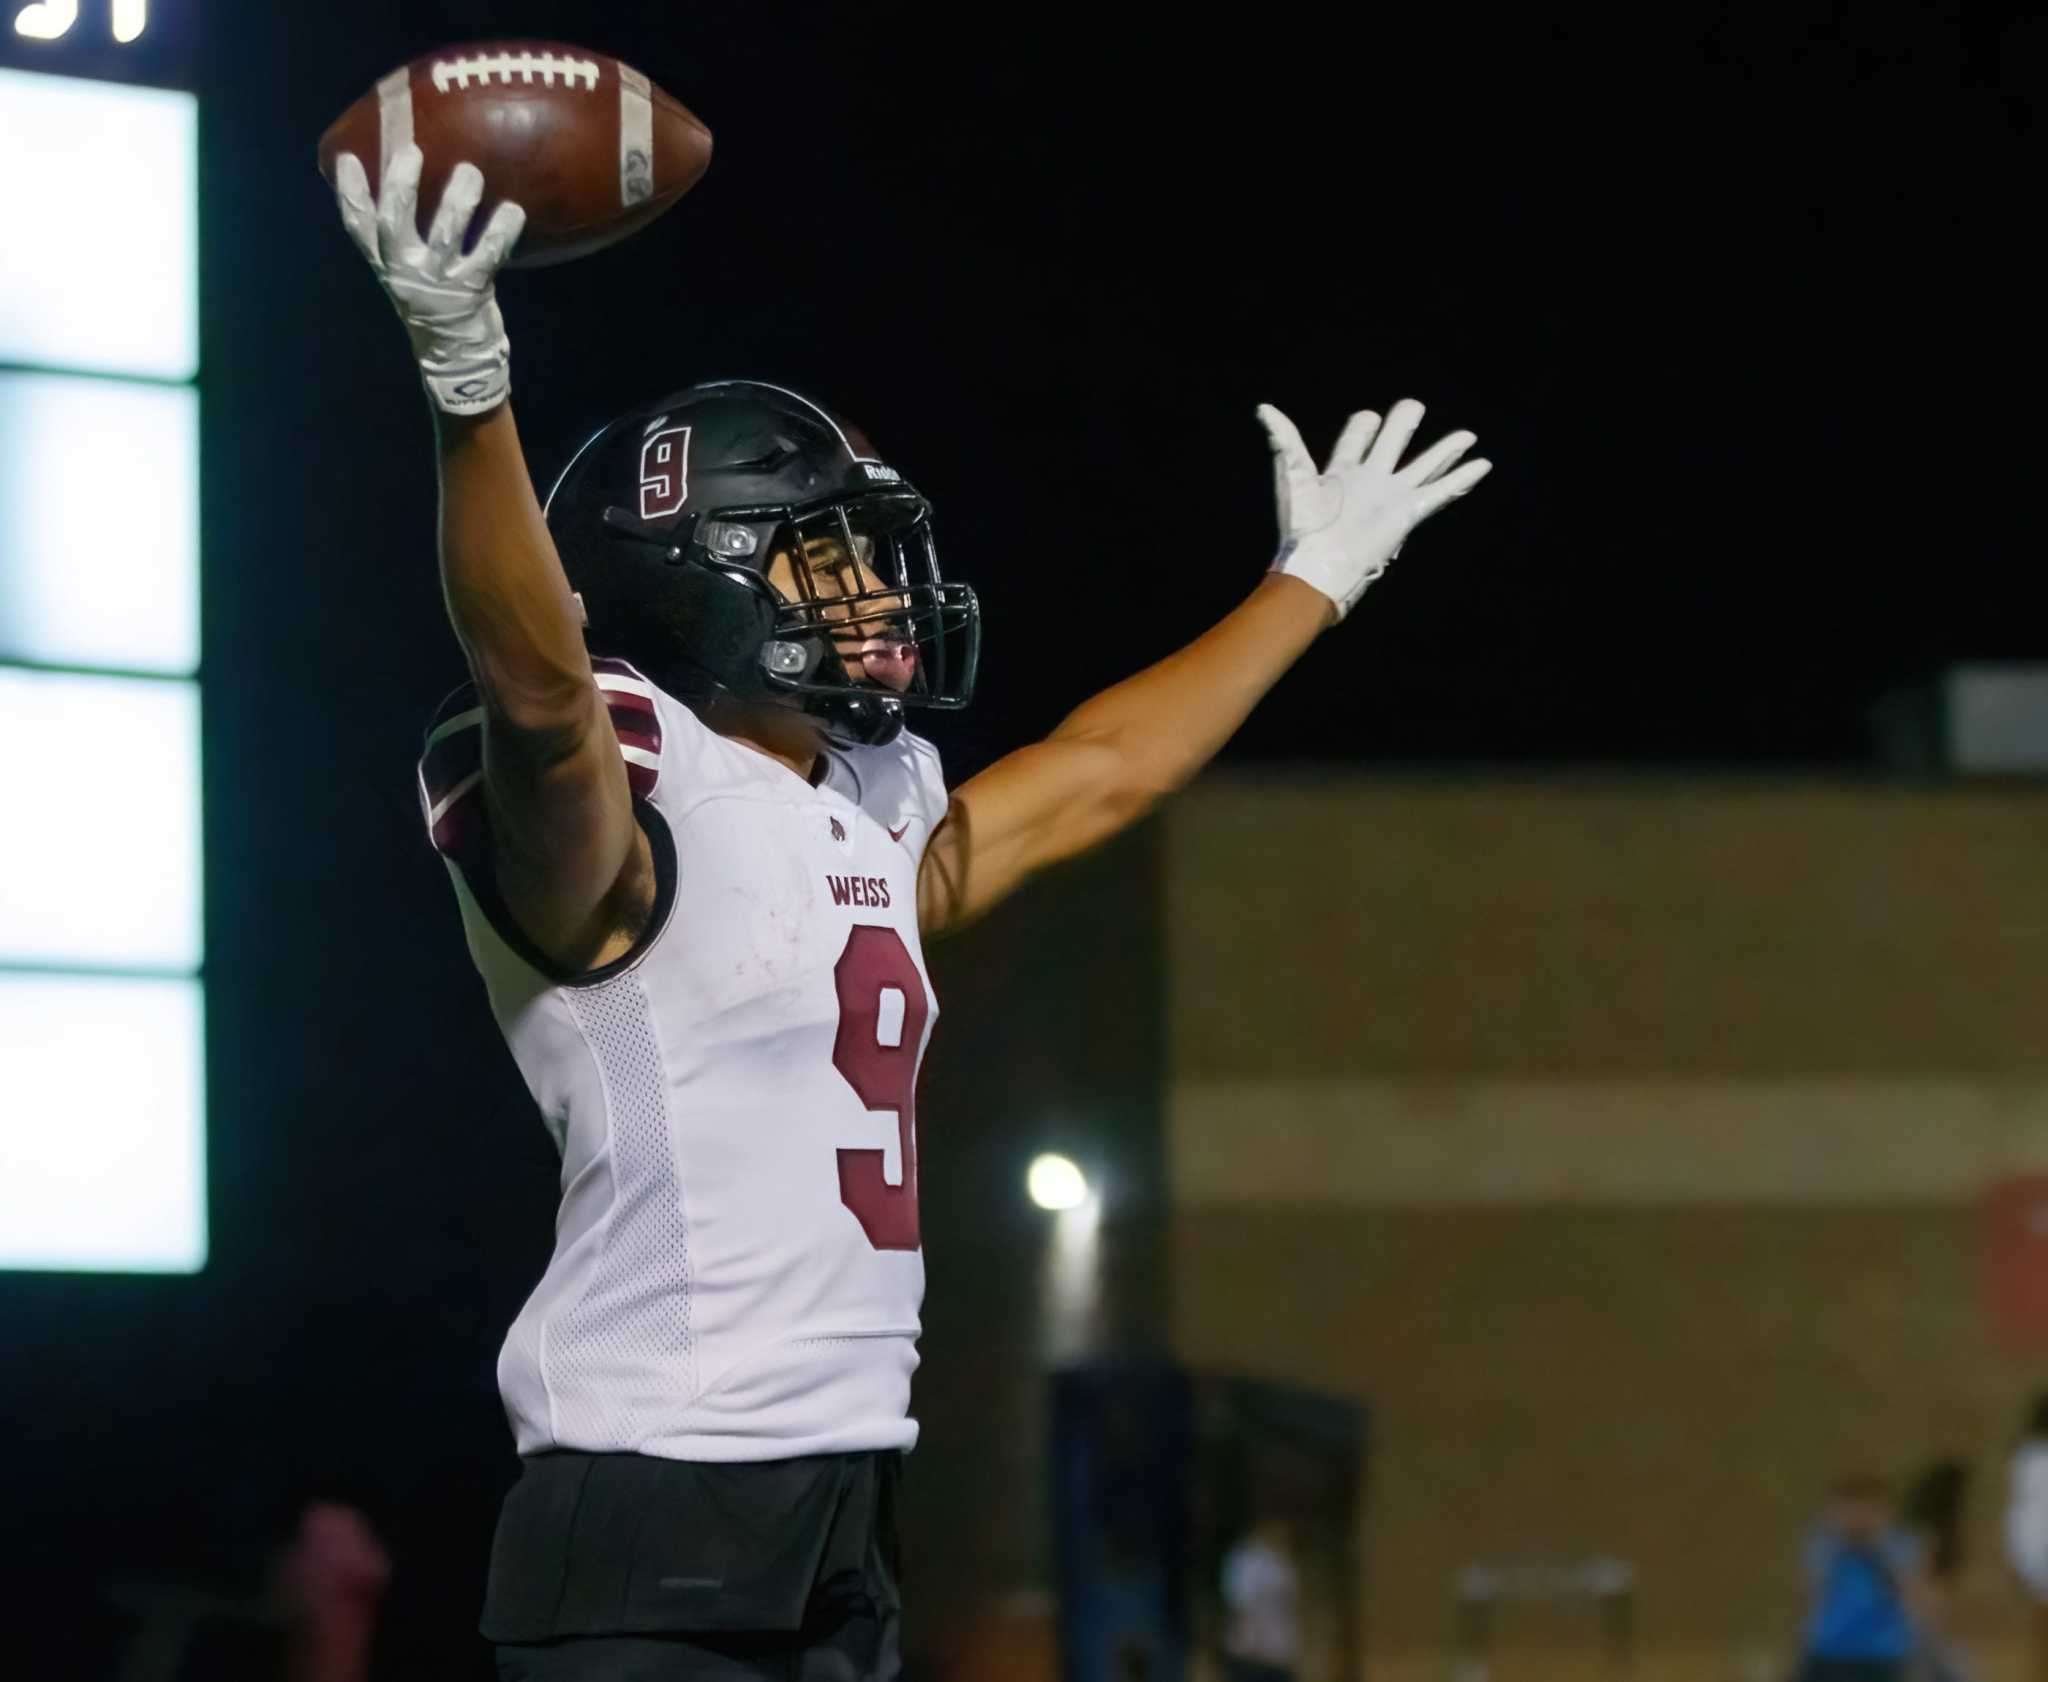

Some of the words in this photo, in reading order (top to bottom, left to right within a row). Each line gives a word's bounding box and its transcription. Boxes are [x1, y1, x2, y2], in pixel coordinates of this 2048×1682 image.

[639, 426, 692, 520] 9
[825, 874, 890, 908] WEISS
[832, 923, 929, 1251] 9
